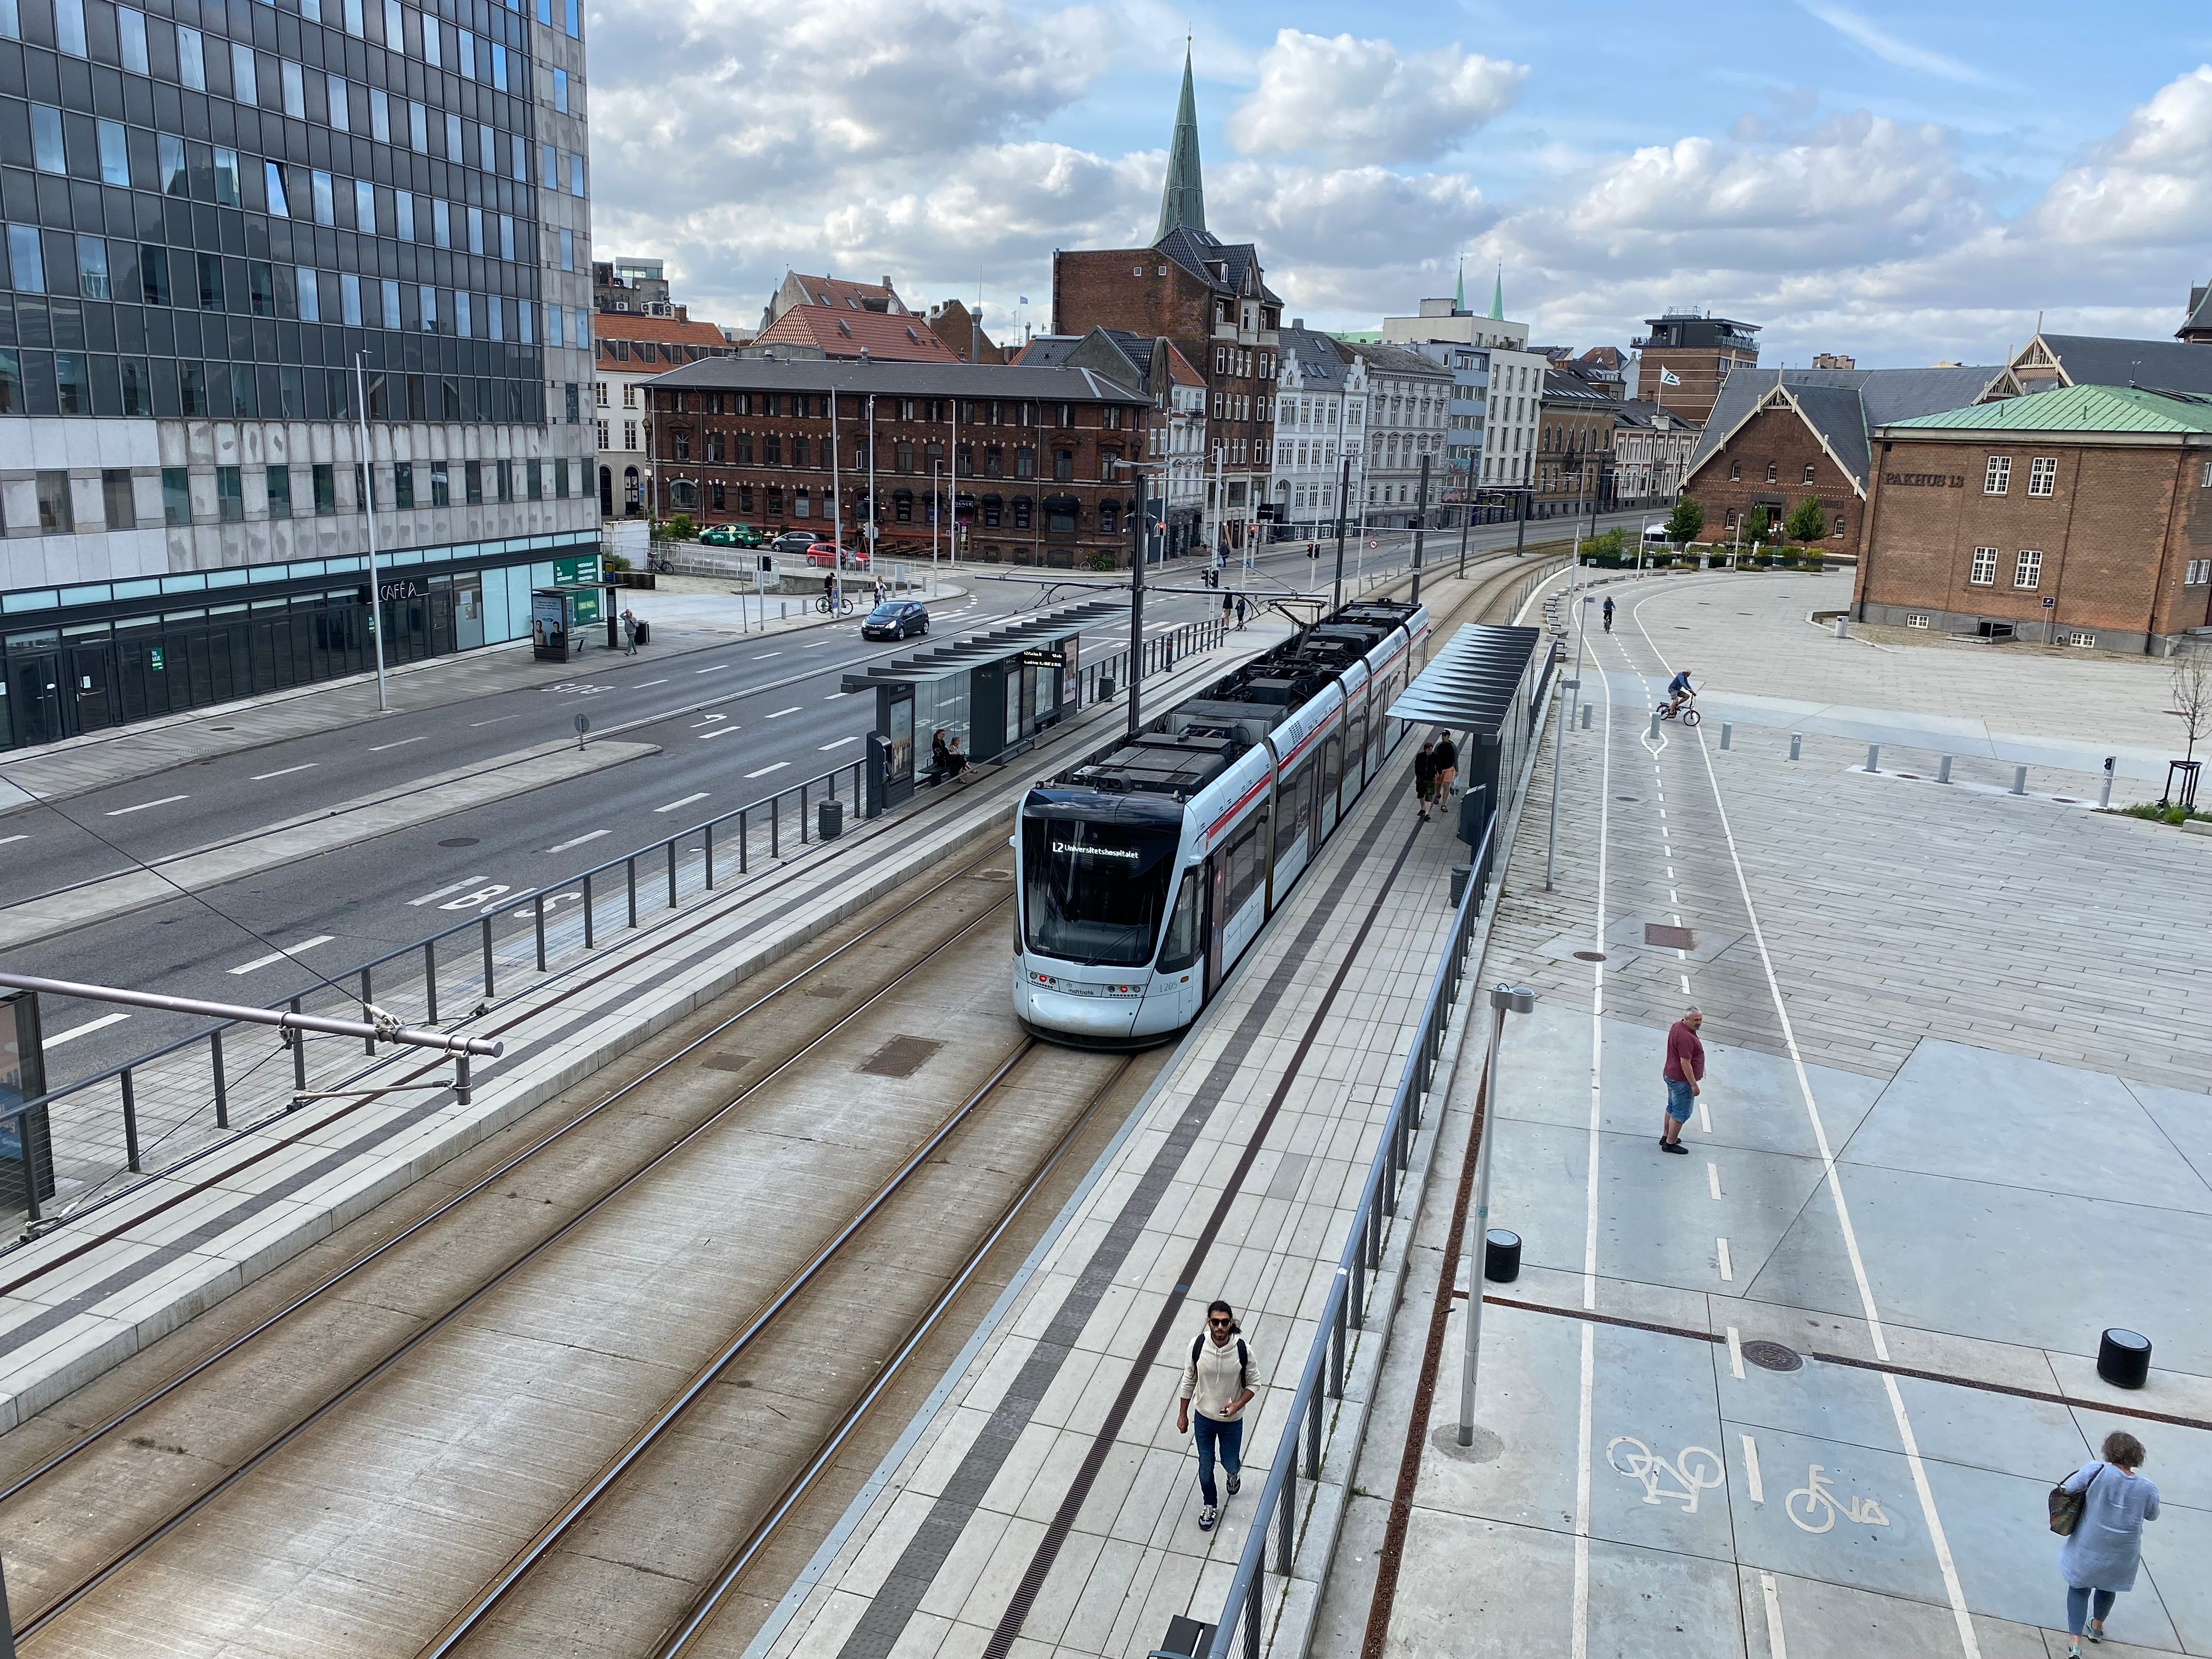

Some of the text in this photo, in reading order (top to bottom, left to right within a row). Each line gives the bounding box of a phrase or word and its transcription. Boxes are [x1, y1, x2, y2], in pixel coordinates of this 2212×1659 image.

[1884, 472, 1945, 487] PAKHUS
[381, 580, 407, 601] CAFÉ
[540, 683, 617, 695] BUS
[1052, 842, 1138, 859] L2 Universitetshospitalet
[1159, 980, 1178, 993] 1205
